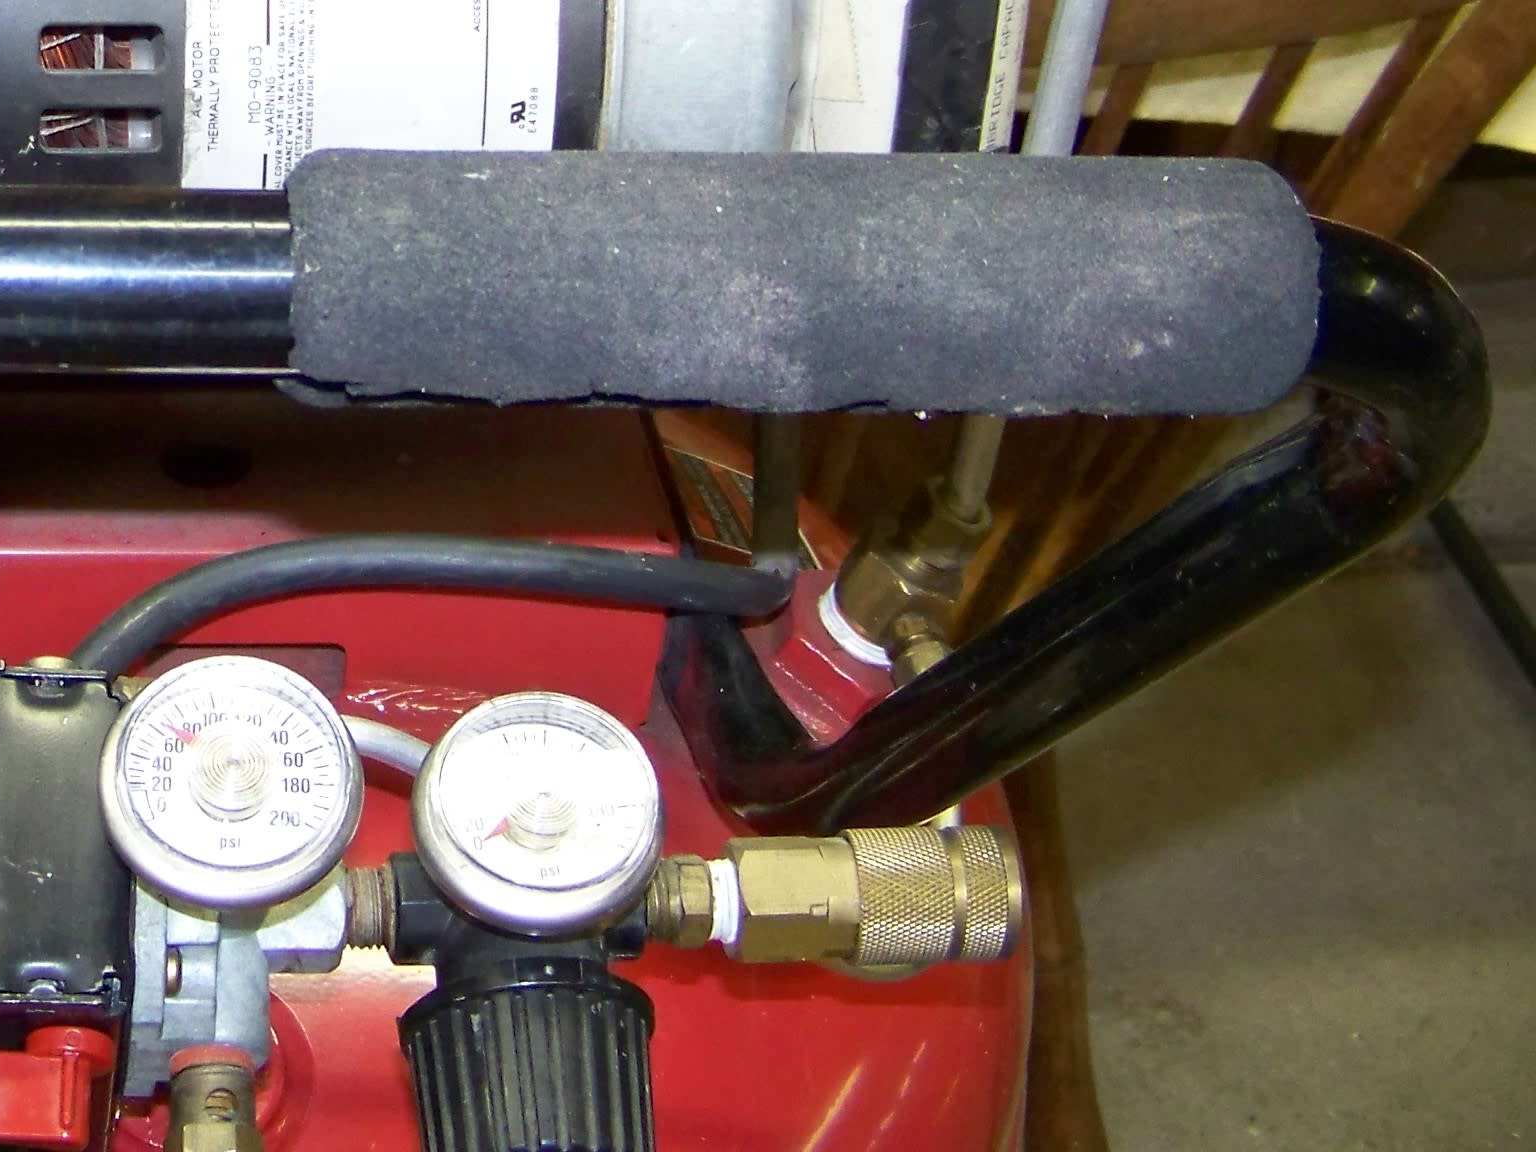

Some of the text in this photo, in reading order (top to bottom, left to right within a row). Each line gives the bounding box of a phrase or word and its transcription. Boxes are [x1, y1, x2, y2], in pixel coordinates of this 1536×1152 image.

[277, 41, 285, 59] FOR
[297, 28, 305, 75] OPENINGS
[192, 41, 203, 89] MOTOR
[277, 64, 285, 92] PLACE
[296, 79, 304, 102] FROM
[306, 75, 314, 107] BEFORE
[207, 81, 219, 152] THERMALLY
[264, 77, 275, 136] WARNING
[276, 124, 284, 146] MUST
[305, 111, 313, 150] SOURCES
[275, 150, 283, 177] COVER
[164, 737, 184, 754] 60
[152, 756, 172, 773] 40
[152, 776, 172, 793] 20
[281, 777, 310, 794] 180
[269, 809, 301, 827] 200
[219, 837, 241, 850] psi
